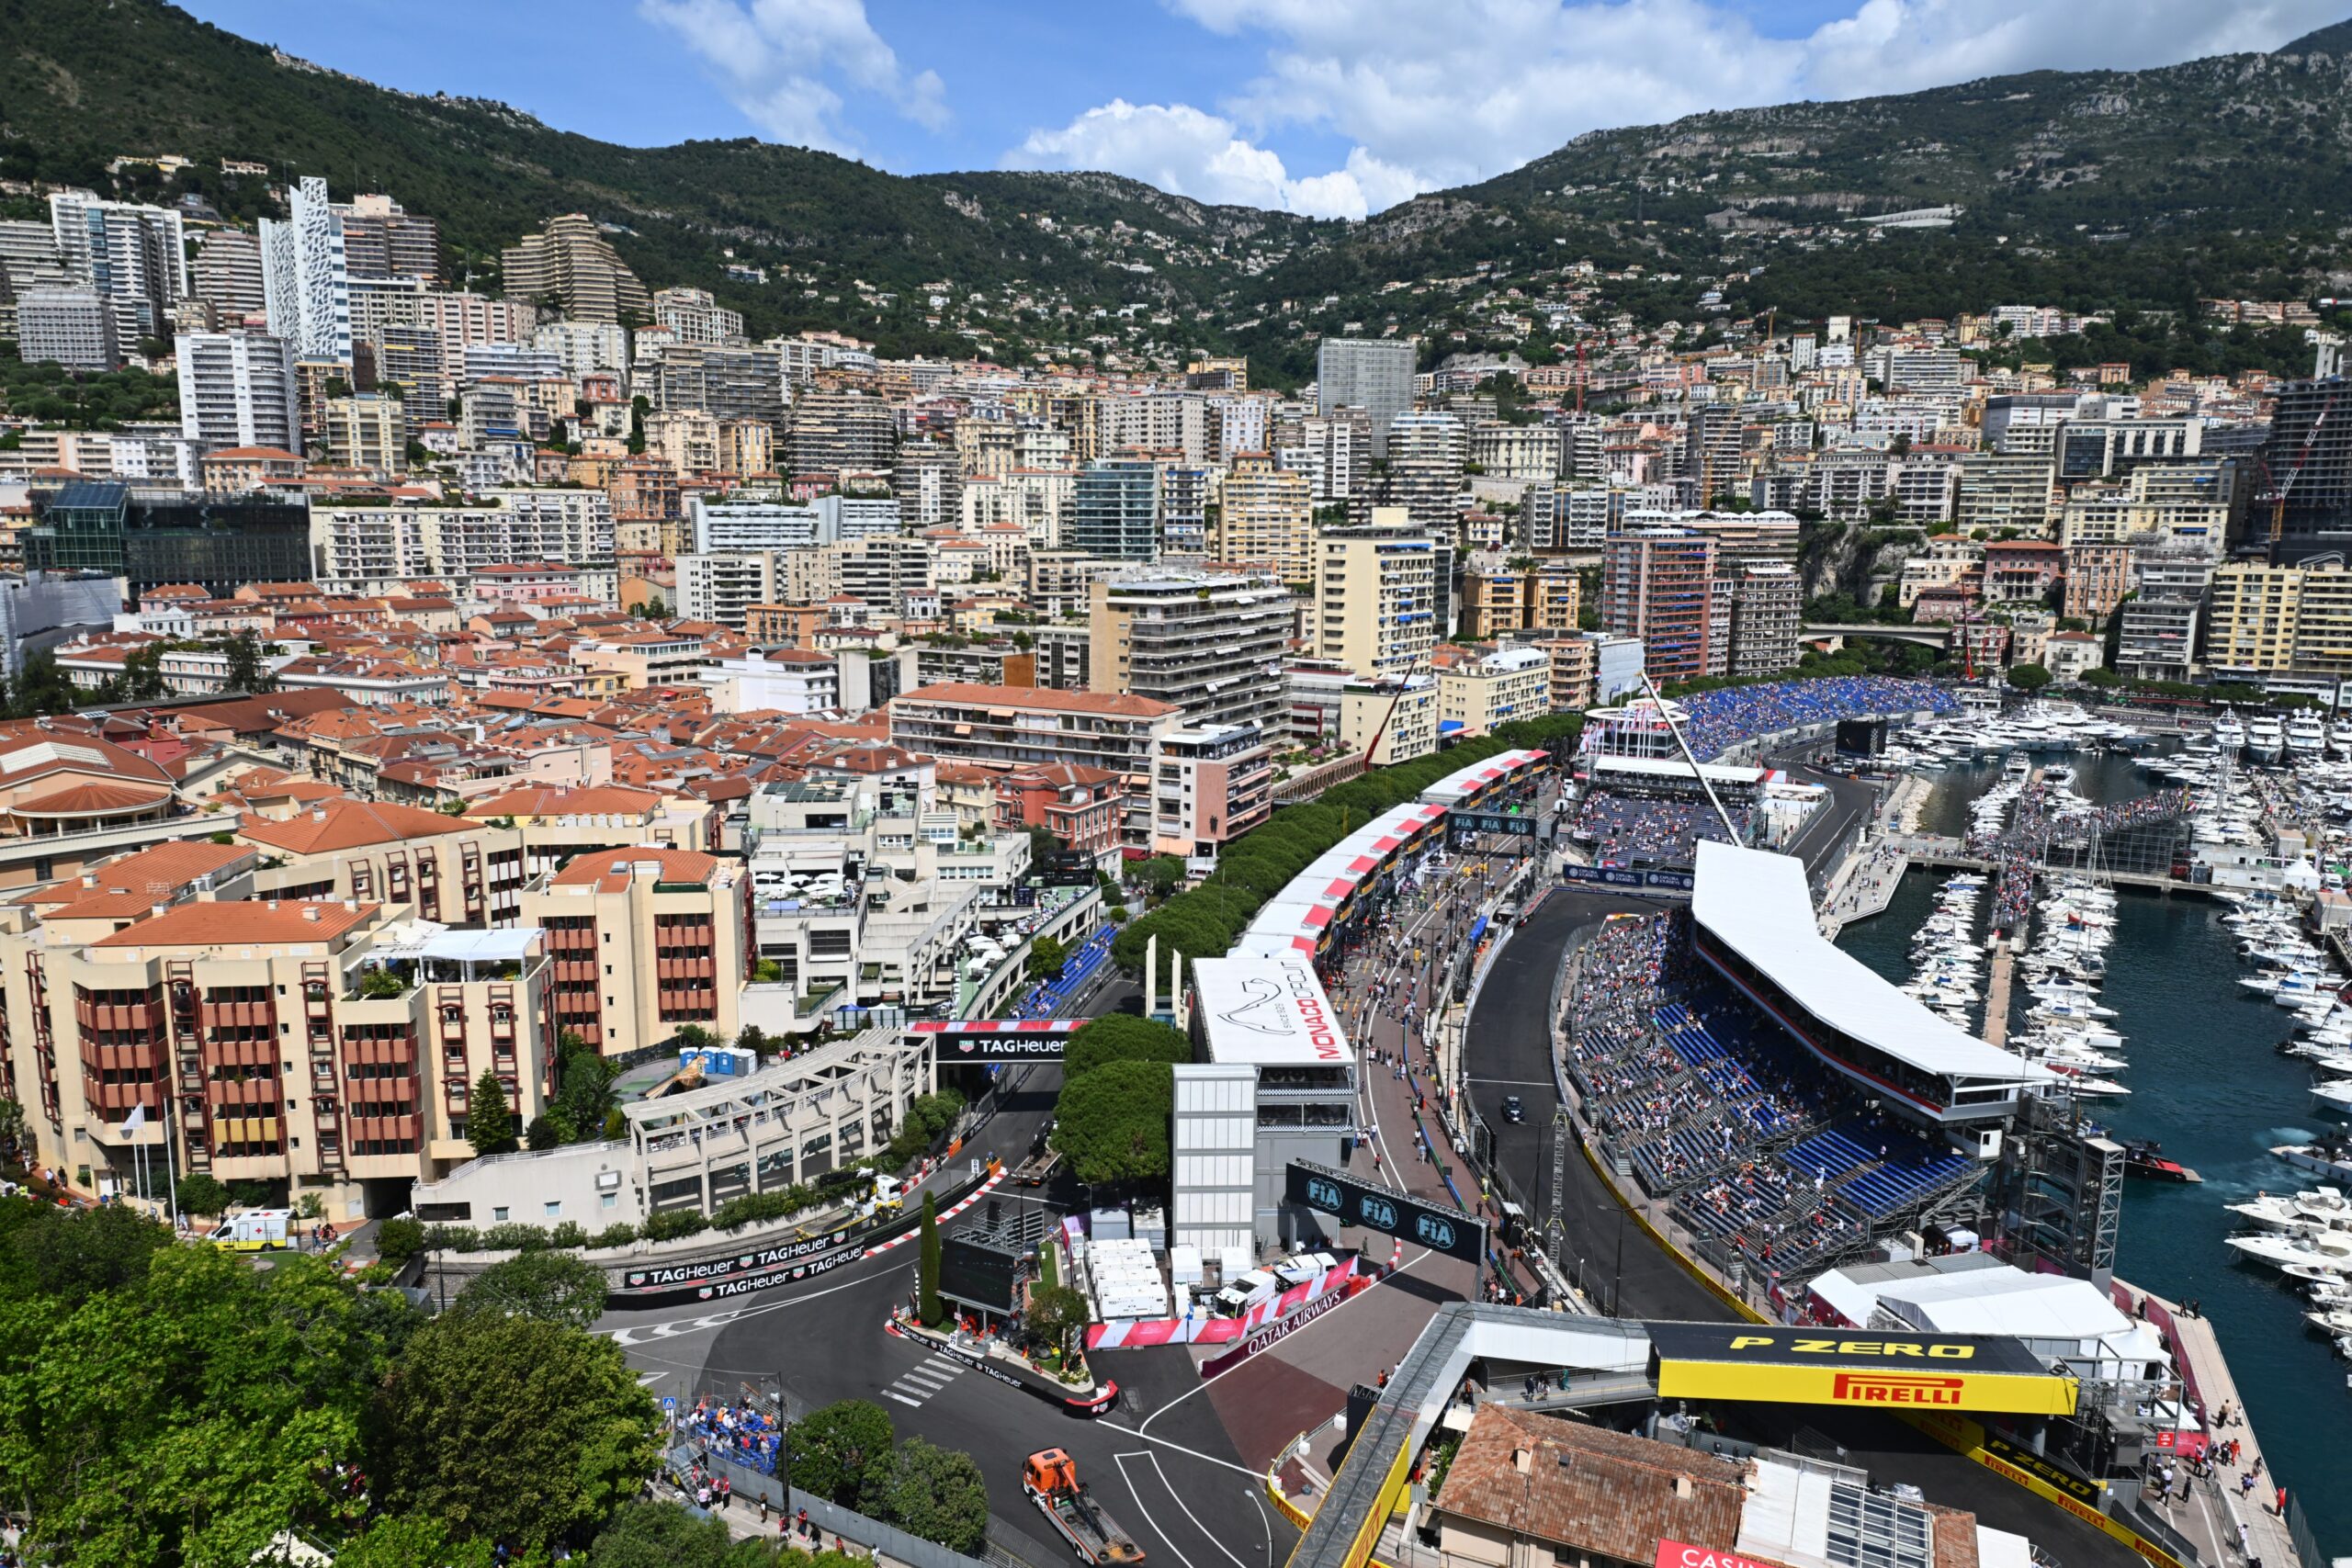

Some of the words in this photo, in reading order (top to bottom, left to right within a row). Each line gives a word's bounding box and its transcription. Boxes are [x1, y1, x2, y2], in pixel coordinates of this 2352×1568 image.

[1295, 998, 1341, 1059] MONACO
[1248, 1320, 1289, 1355] QATAR
[1292, 1289, 1340, 1330] AIRWAYS
[1730, 1337, 1775, 1349] P
[1791, 1339, 1975, 1359] ZERO
[1833, 1373, 1964, 1404] PIRELLI
[1984, 1454, 2030, 1486] PIRELLI
[1989, 1439, 2011, 1452] P
[2013, 1451, 2091, 1496] ZERO
[2058, 1494, 2107, 1529] PIRELLI
